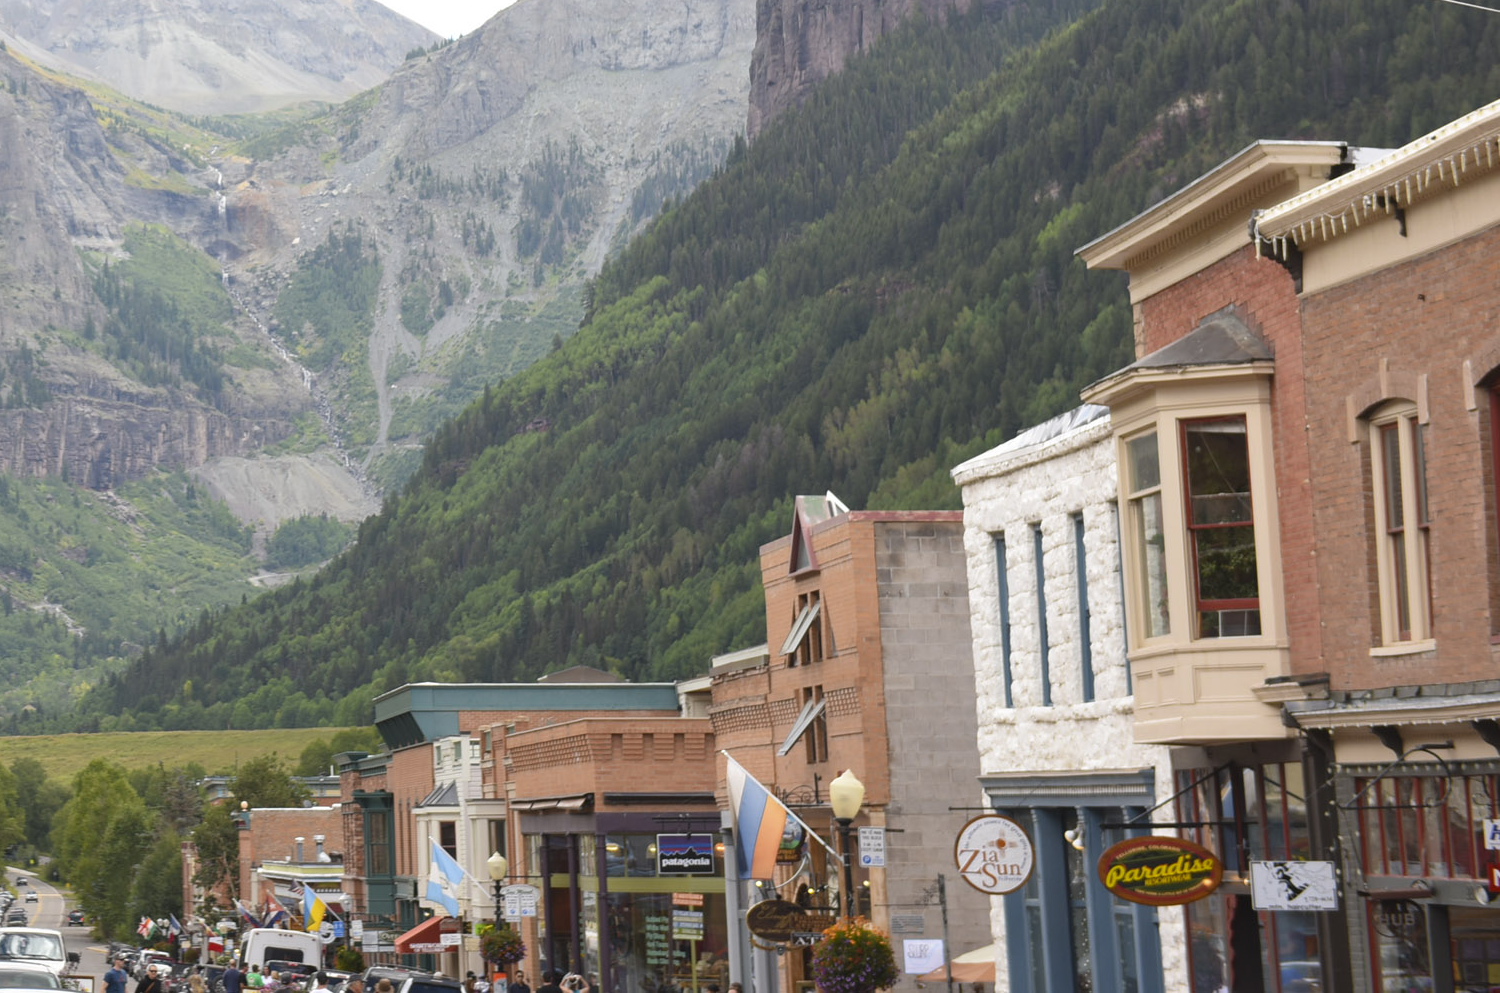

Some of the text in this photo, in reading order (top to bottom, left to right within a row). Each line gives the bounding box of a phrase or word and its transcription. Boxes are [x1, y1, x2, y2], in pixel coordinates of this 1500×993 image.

[661, 857, 711, 868] patagonia
[959, 844, 999, 874] Zia
[982, 862, 1021, 888] Sun
[1106, 854, 1214, 888] Paradise
[1144, 873, 1192, 886] RESORTWEAR
[1380, 912, 1416, 925] HUB
